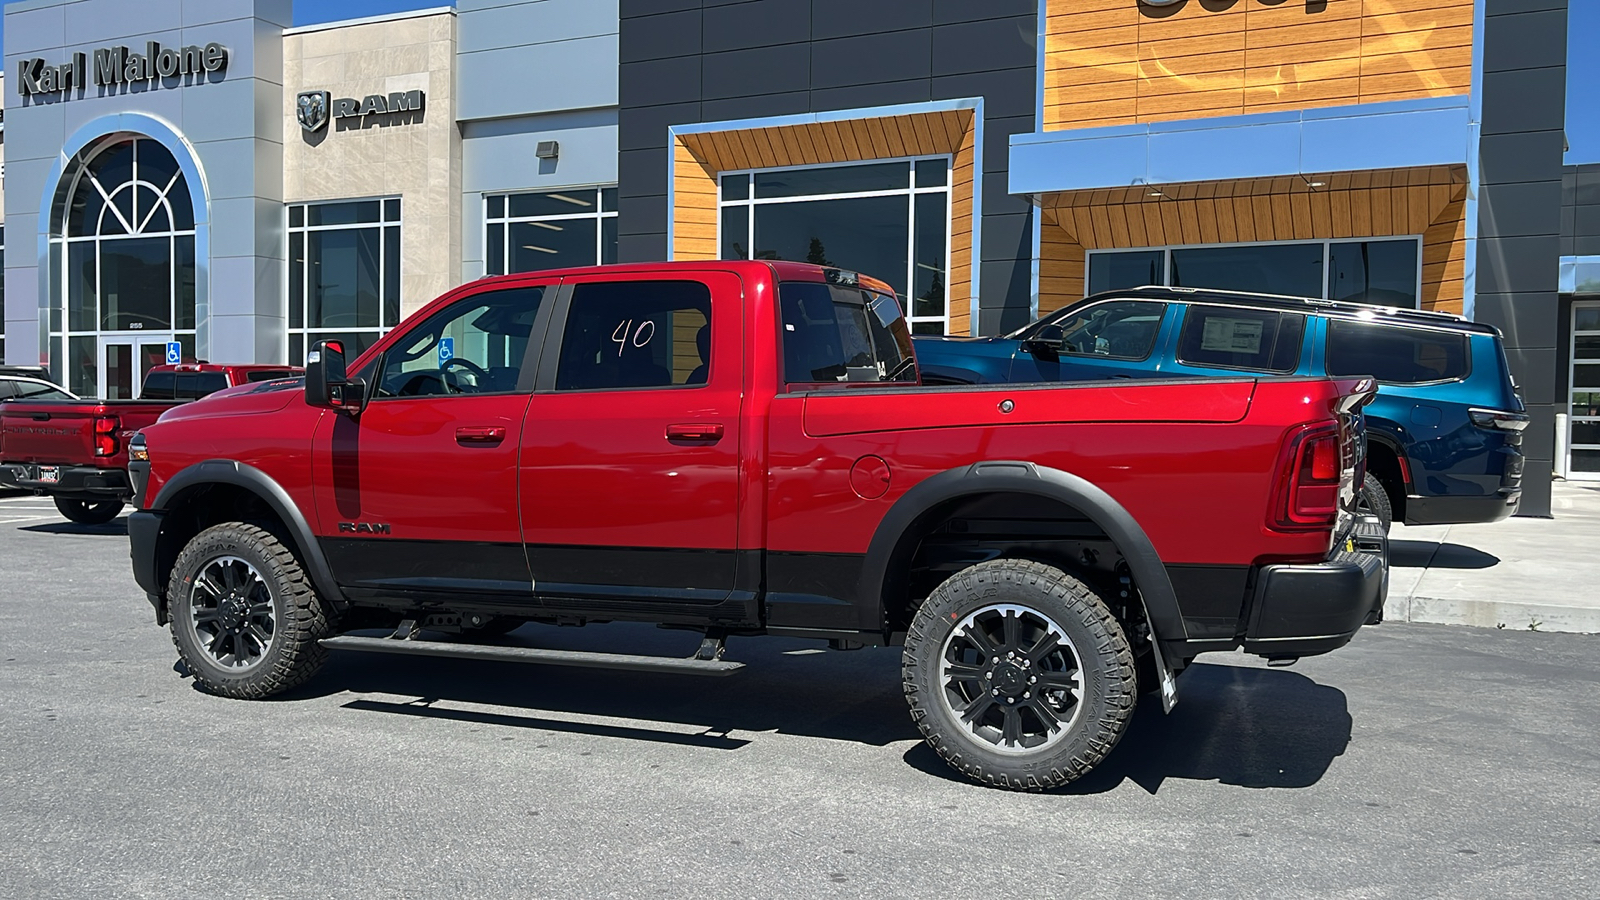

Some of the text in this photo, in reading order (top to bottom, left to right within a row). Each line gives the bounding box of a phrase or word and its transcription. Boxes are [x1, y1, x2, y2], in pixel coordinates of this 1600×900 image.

[18, 41, 227, 95] Karl Malone
[333, 89, 425, 118] RAM
[611, 319, 655, 357] 40
[338, 522, 391, 535] RAM
